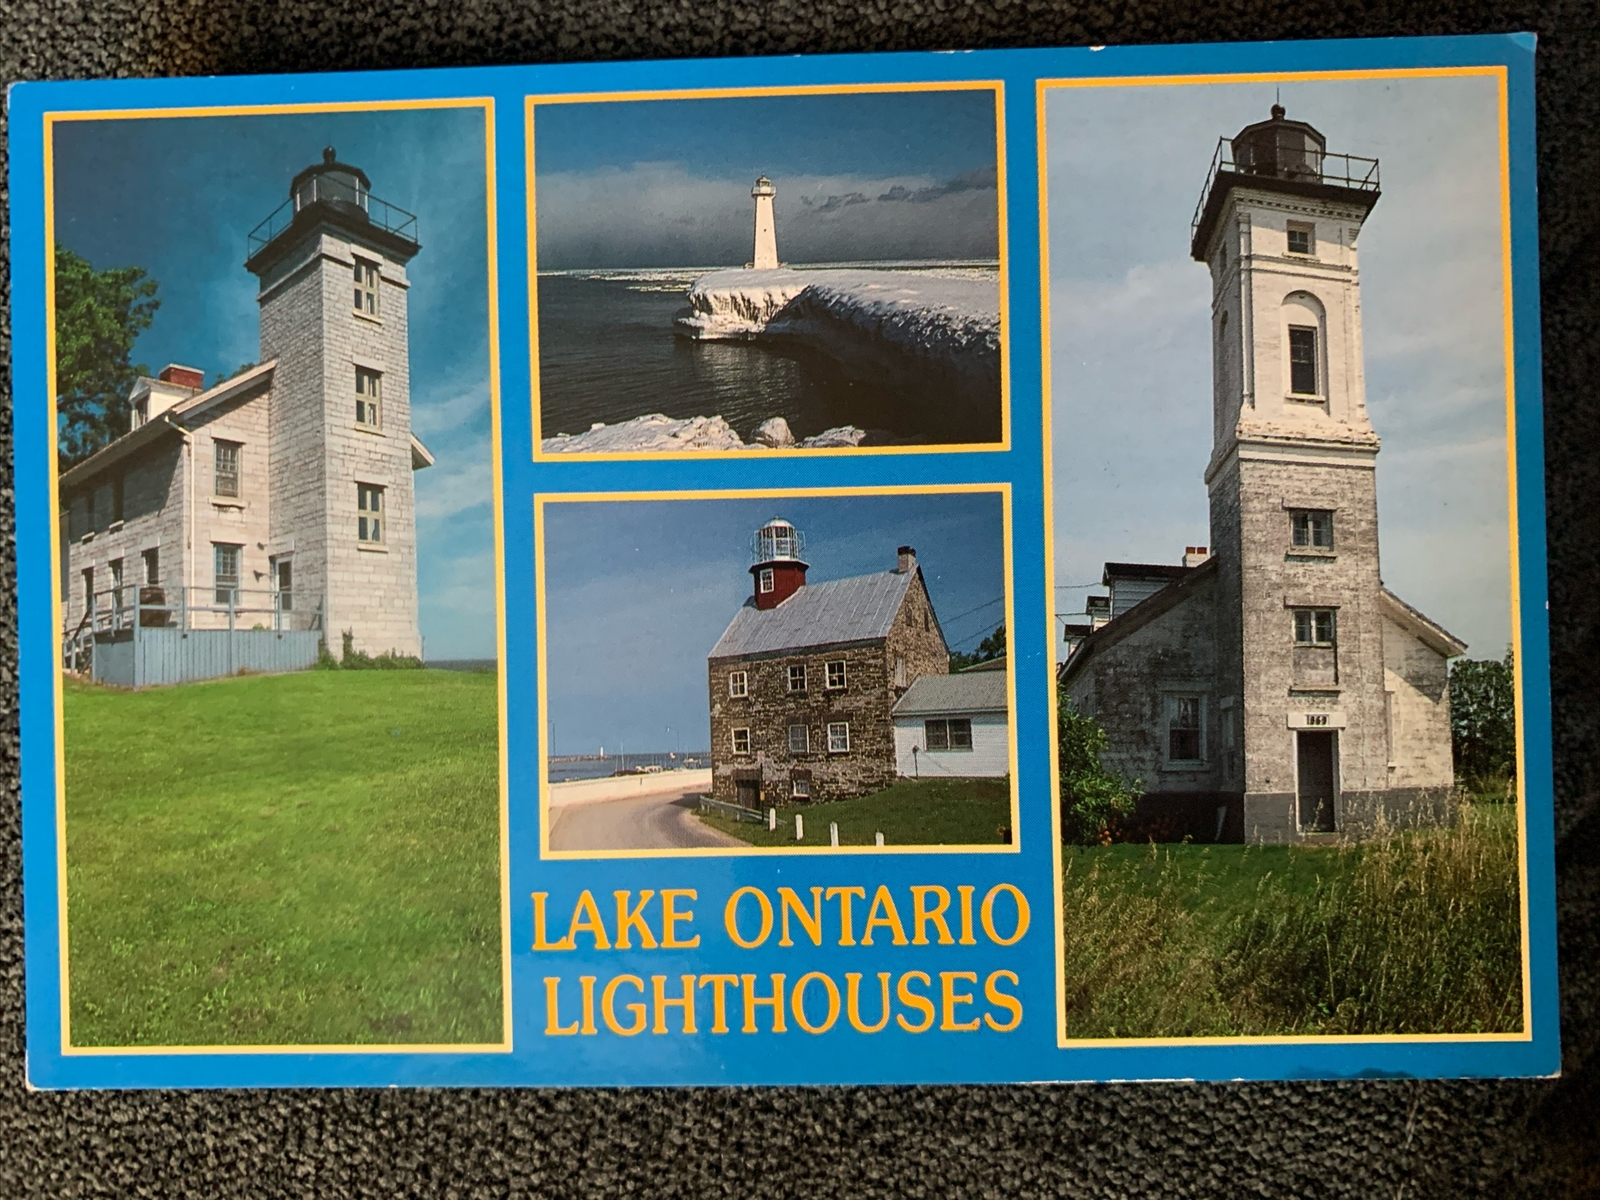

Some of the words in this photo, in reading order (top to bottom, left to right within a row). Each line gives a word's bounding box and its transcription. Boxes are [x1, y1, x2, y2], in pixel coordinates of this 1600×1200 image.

[532, 889, 701, 951] LAKE
[724, 884, 1031, 948] ONTARIO
[545, 970, 1023, 1036] LIGHTHOUSES
